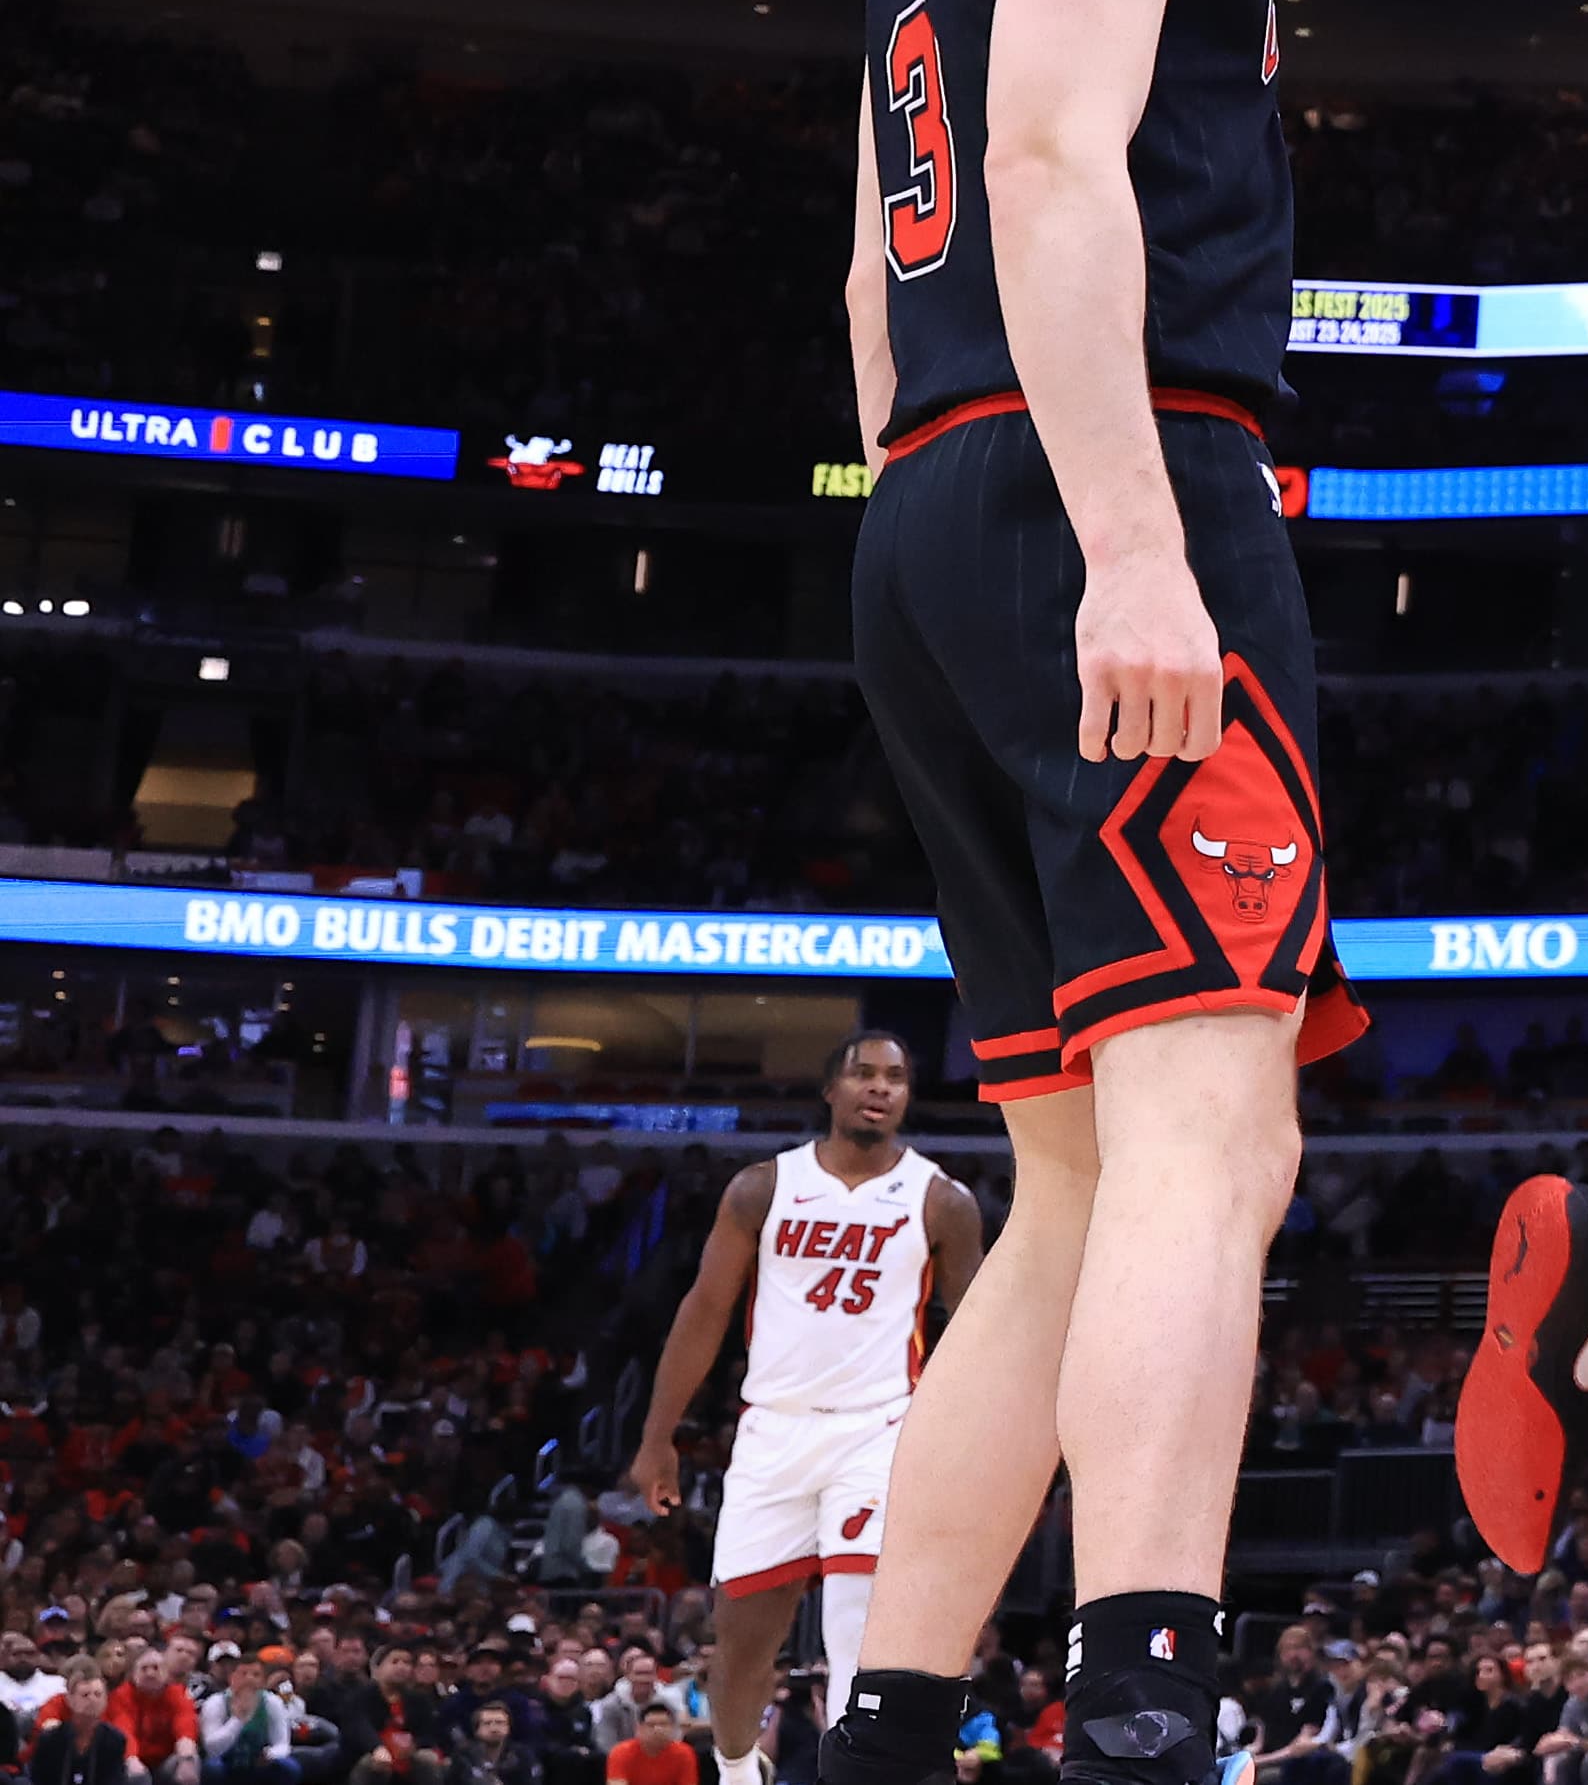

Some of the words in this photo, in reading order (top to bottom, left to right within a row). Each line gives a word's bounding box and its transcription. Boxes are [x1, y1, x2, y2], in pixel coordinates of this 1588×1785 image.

[1358, 292, 1410, 321] 2025
[70, 408, 198, 449] ULTRA
[243, 424, 380, 464] CLUB
[185, 898, 301, 947] BMO
[312, 906, 457, 958] BULLS
[471, 915, 606, 963] DEBIT
[1428, 921, 1580, 971] BMO
[775, 1214, 910, 1264] HEAT
[806, 1266, 882, 1315] 45
